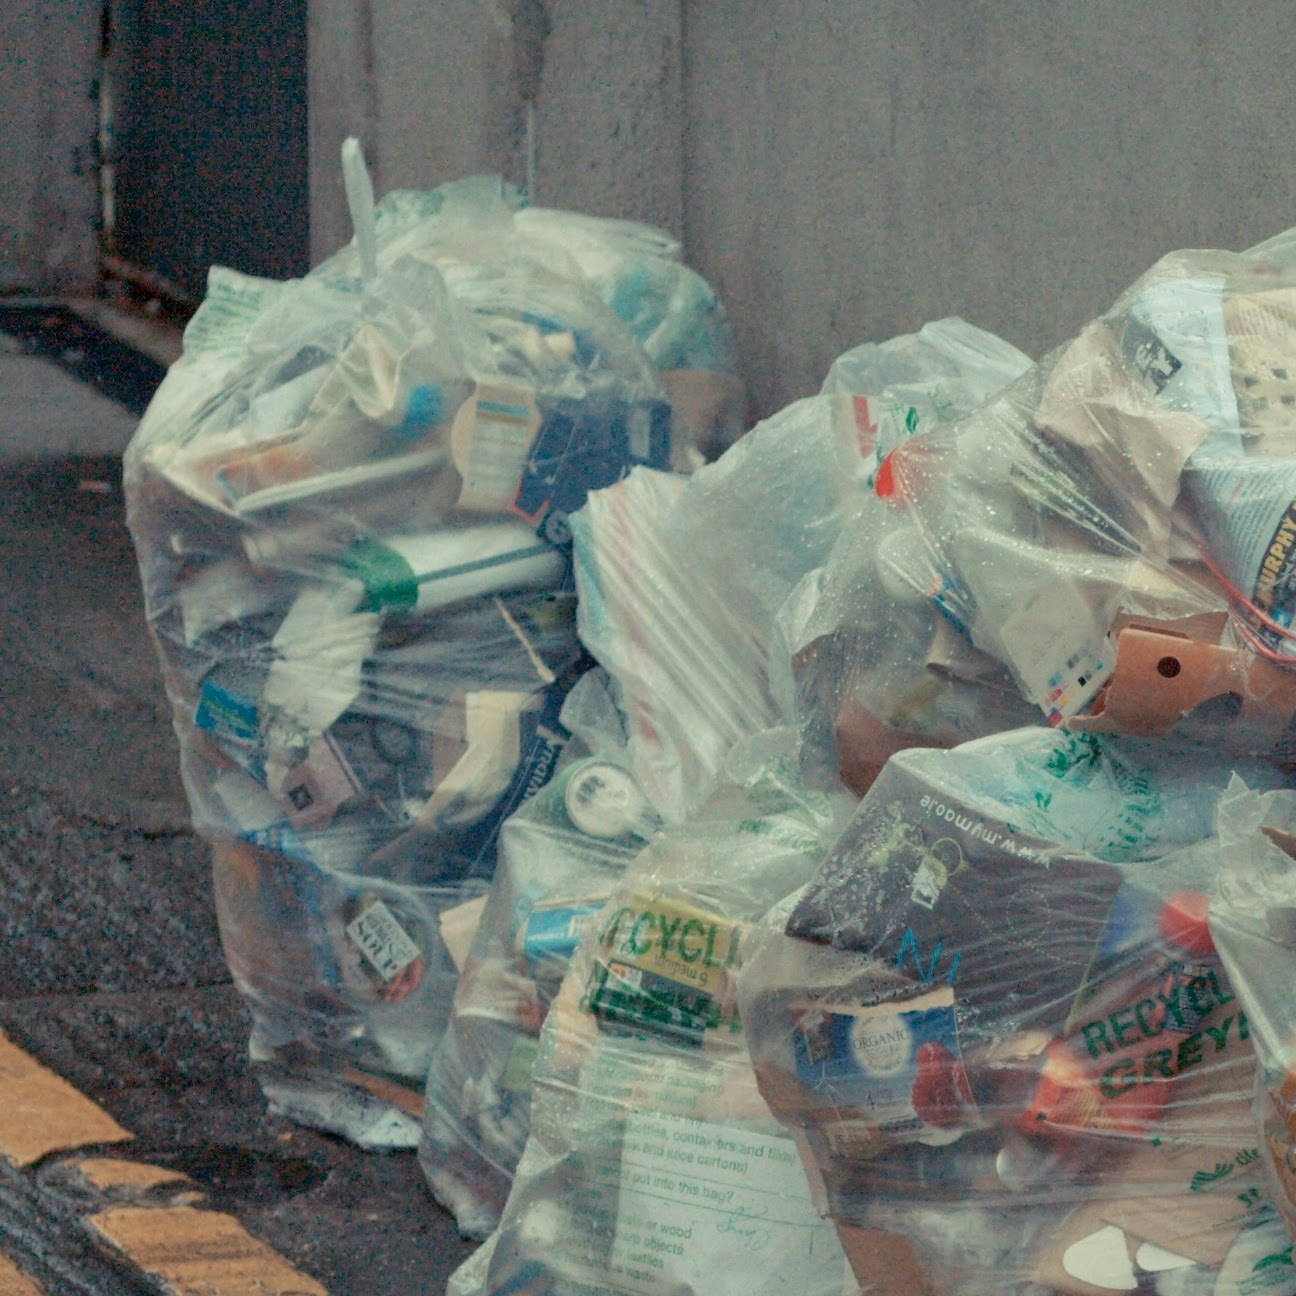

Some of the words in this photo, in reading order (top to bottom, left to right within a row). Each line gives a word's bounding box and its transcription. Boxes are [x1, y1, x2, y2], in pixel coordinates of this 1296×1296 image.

[1081, 970, 1237, 1061] RECYCL
[853, 1030, 909, 1050] ORGANIC
[677, 1180, 700, 1197] this
[702, 1184, 735, 1204] bag?
